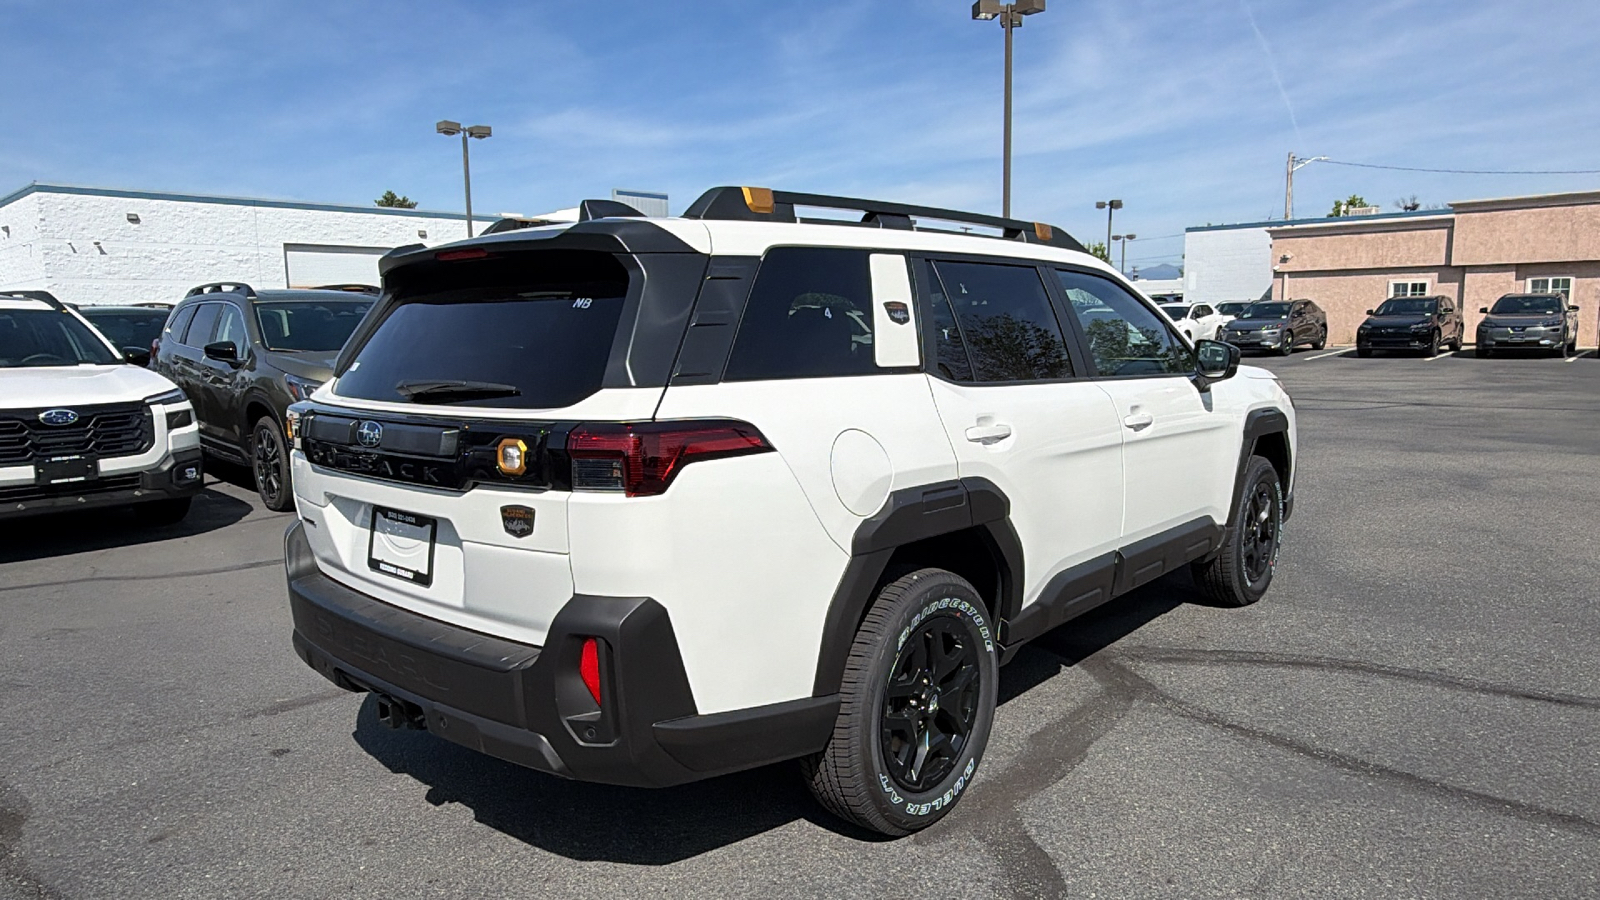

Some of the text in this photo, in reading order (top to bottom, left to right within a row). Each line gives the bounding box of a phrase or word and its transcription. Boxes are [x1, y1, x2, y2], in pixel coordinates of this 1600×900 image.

[572, 297, 593, 309] NB
[898, 598, 994, 652] BRIDGESTONE
[879, 757, 975, 815] DUELER A/T
